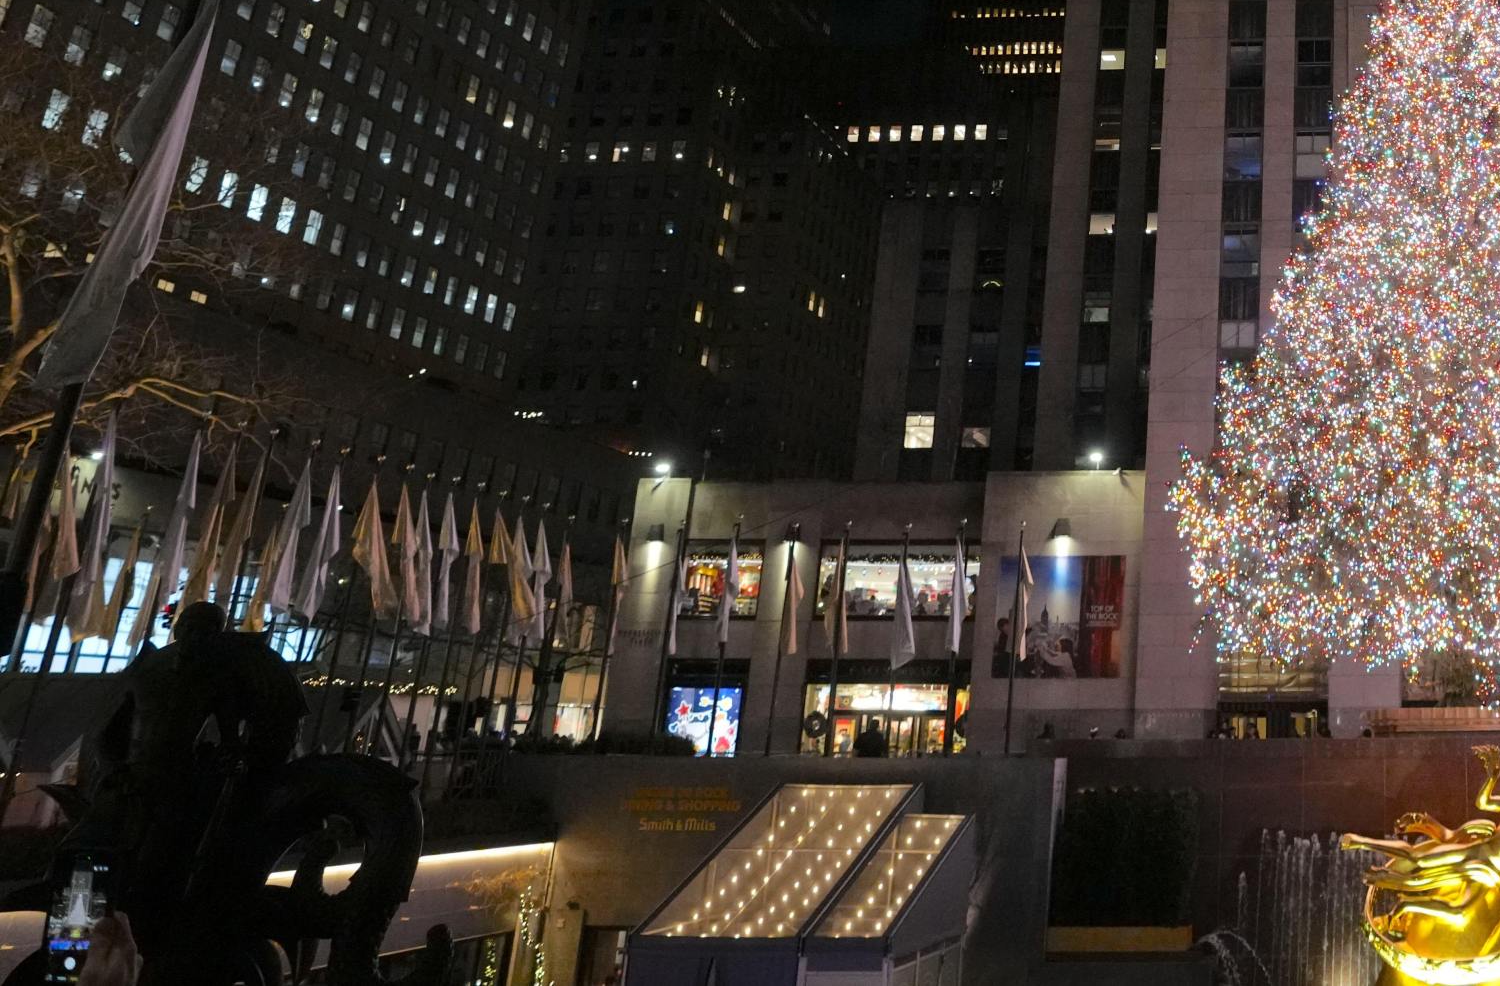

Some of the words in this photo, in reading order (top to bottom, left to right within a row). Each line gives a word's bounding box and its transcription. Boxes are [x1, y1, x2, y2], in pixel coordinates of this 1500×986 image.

[1086, 612, 1097, 620] THE
[1098, 612, 1118, 620] ROCK
[638, 817, 674, 831] Smith
[675, 819, 683, 831] &
[684, 817, 717, 831] Mills
